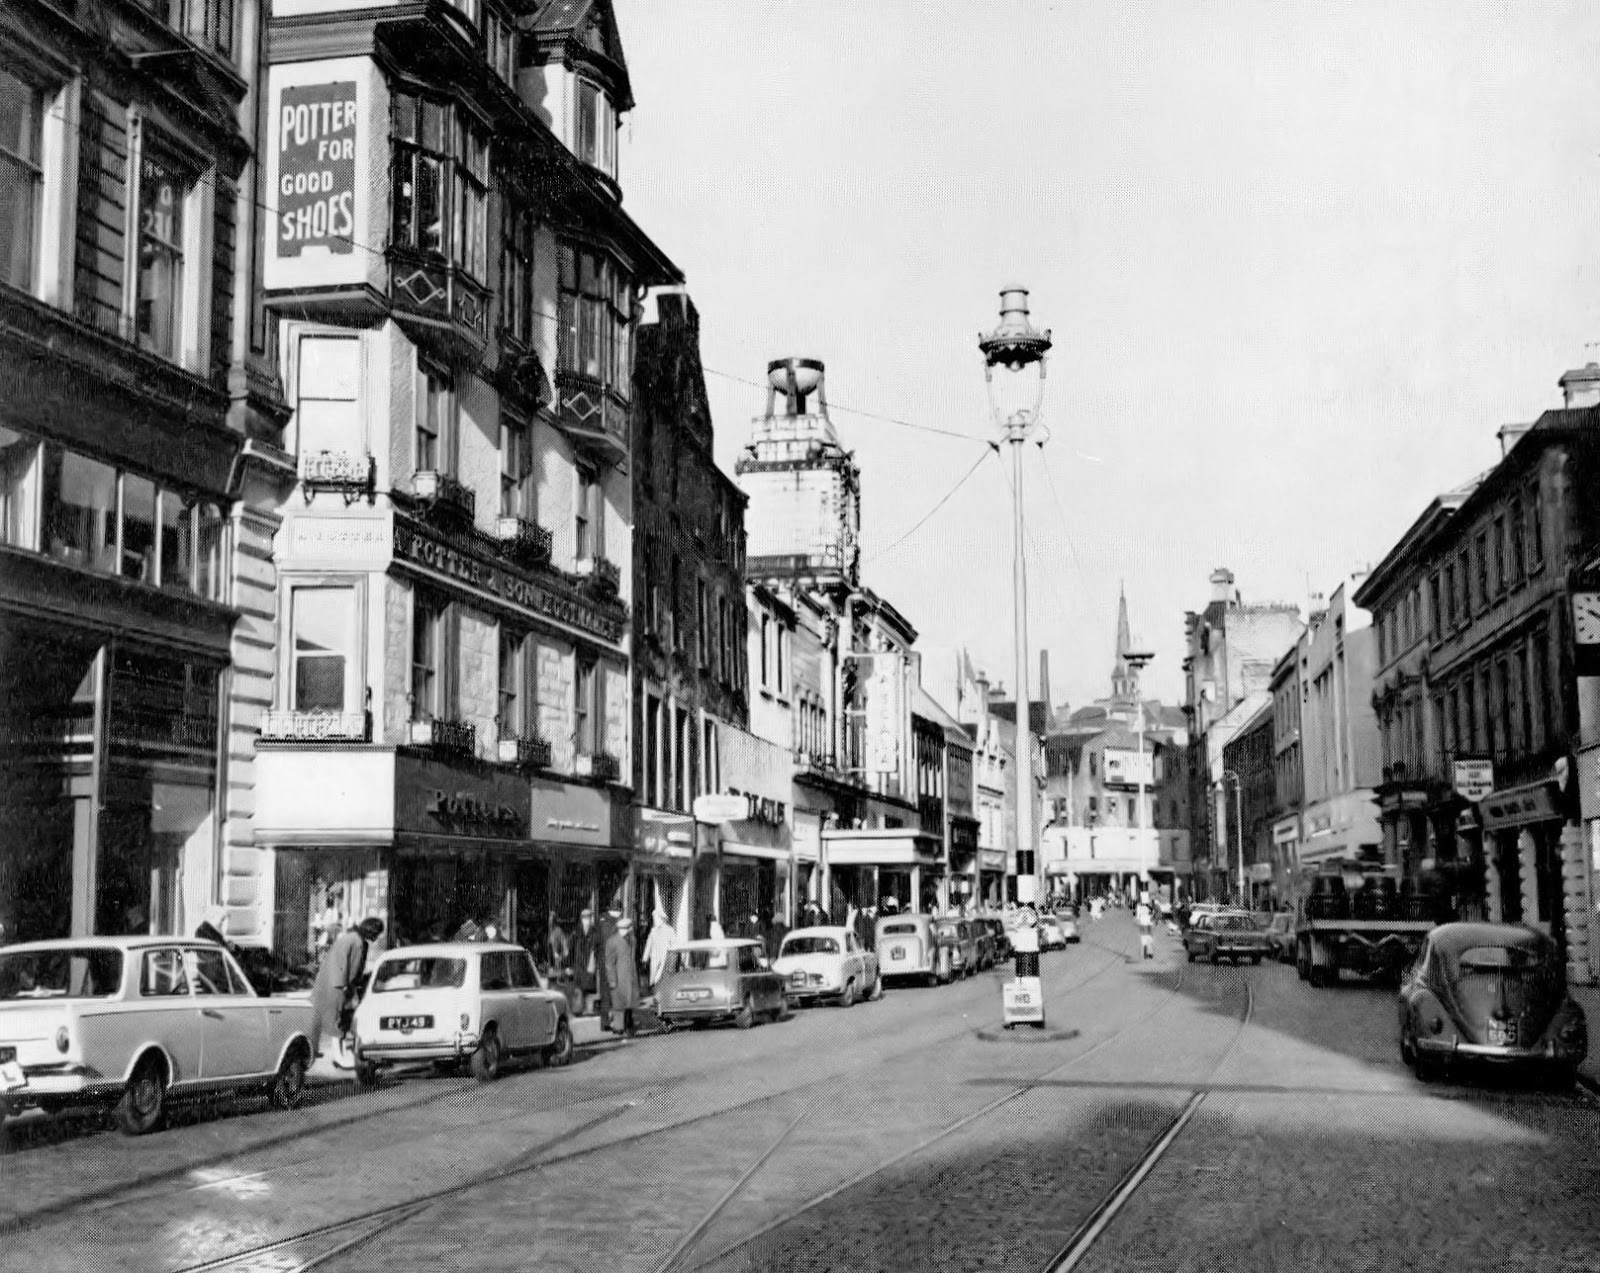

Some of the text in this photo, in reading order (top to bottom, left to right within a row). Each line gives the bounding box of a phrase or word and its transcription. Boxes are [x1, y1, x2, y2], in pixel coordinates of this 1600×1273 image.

[280, 101, 356, 151] POTTER
[318, 138, 354, 161] FOR
[280, 170, 333, 196] GOOD
[281, 191, 353, 240] SHOES
[411, 534, 482, 584] POTTER
